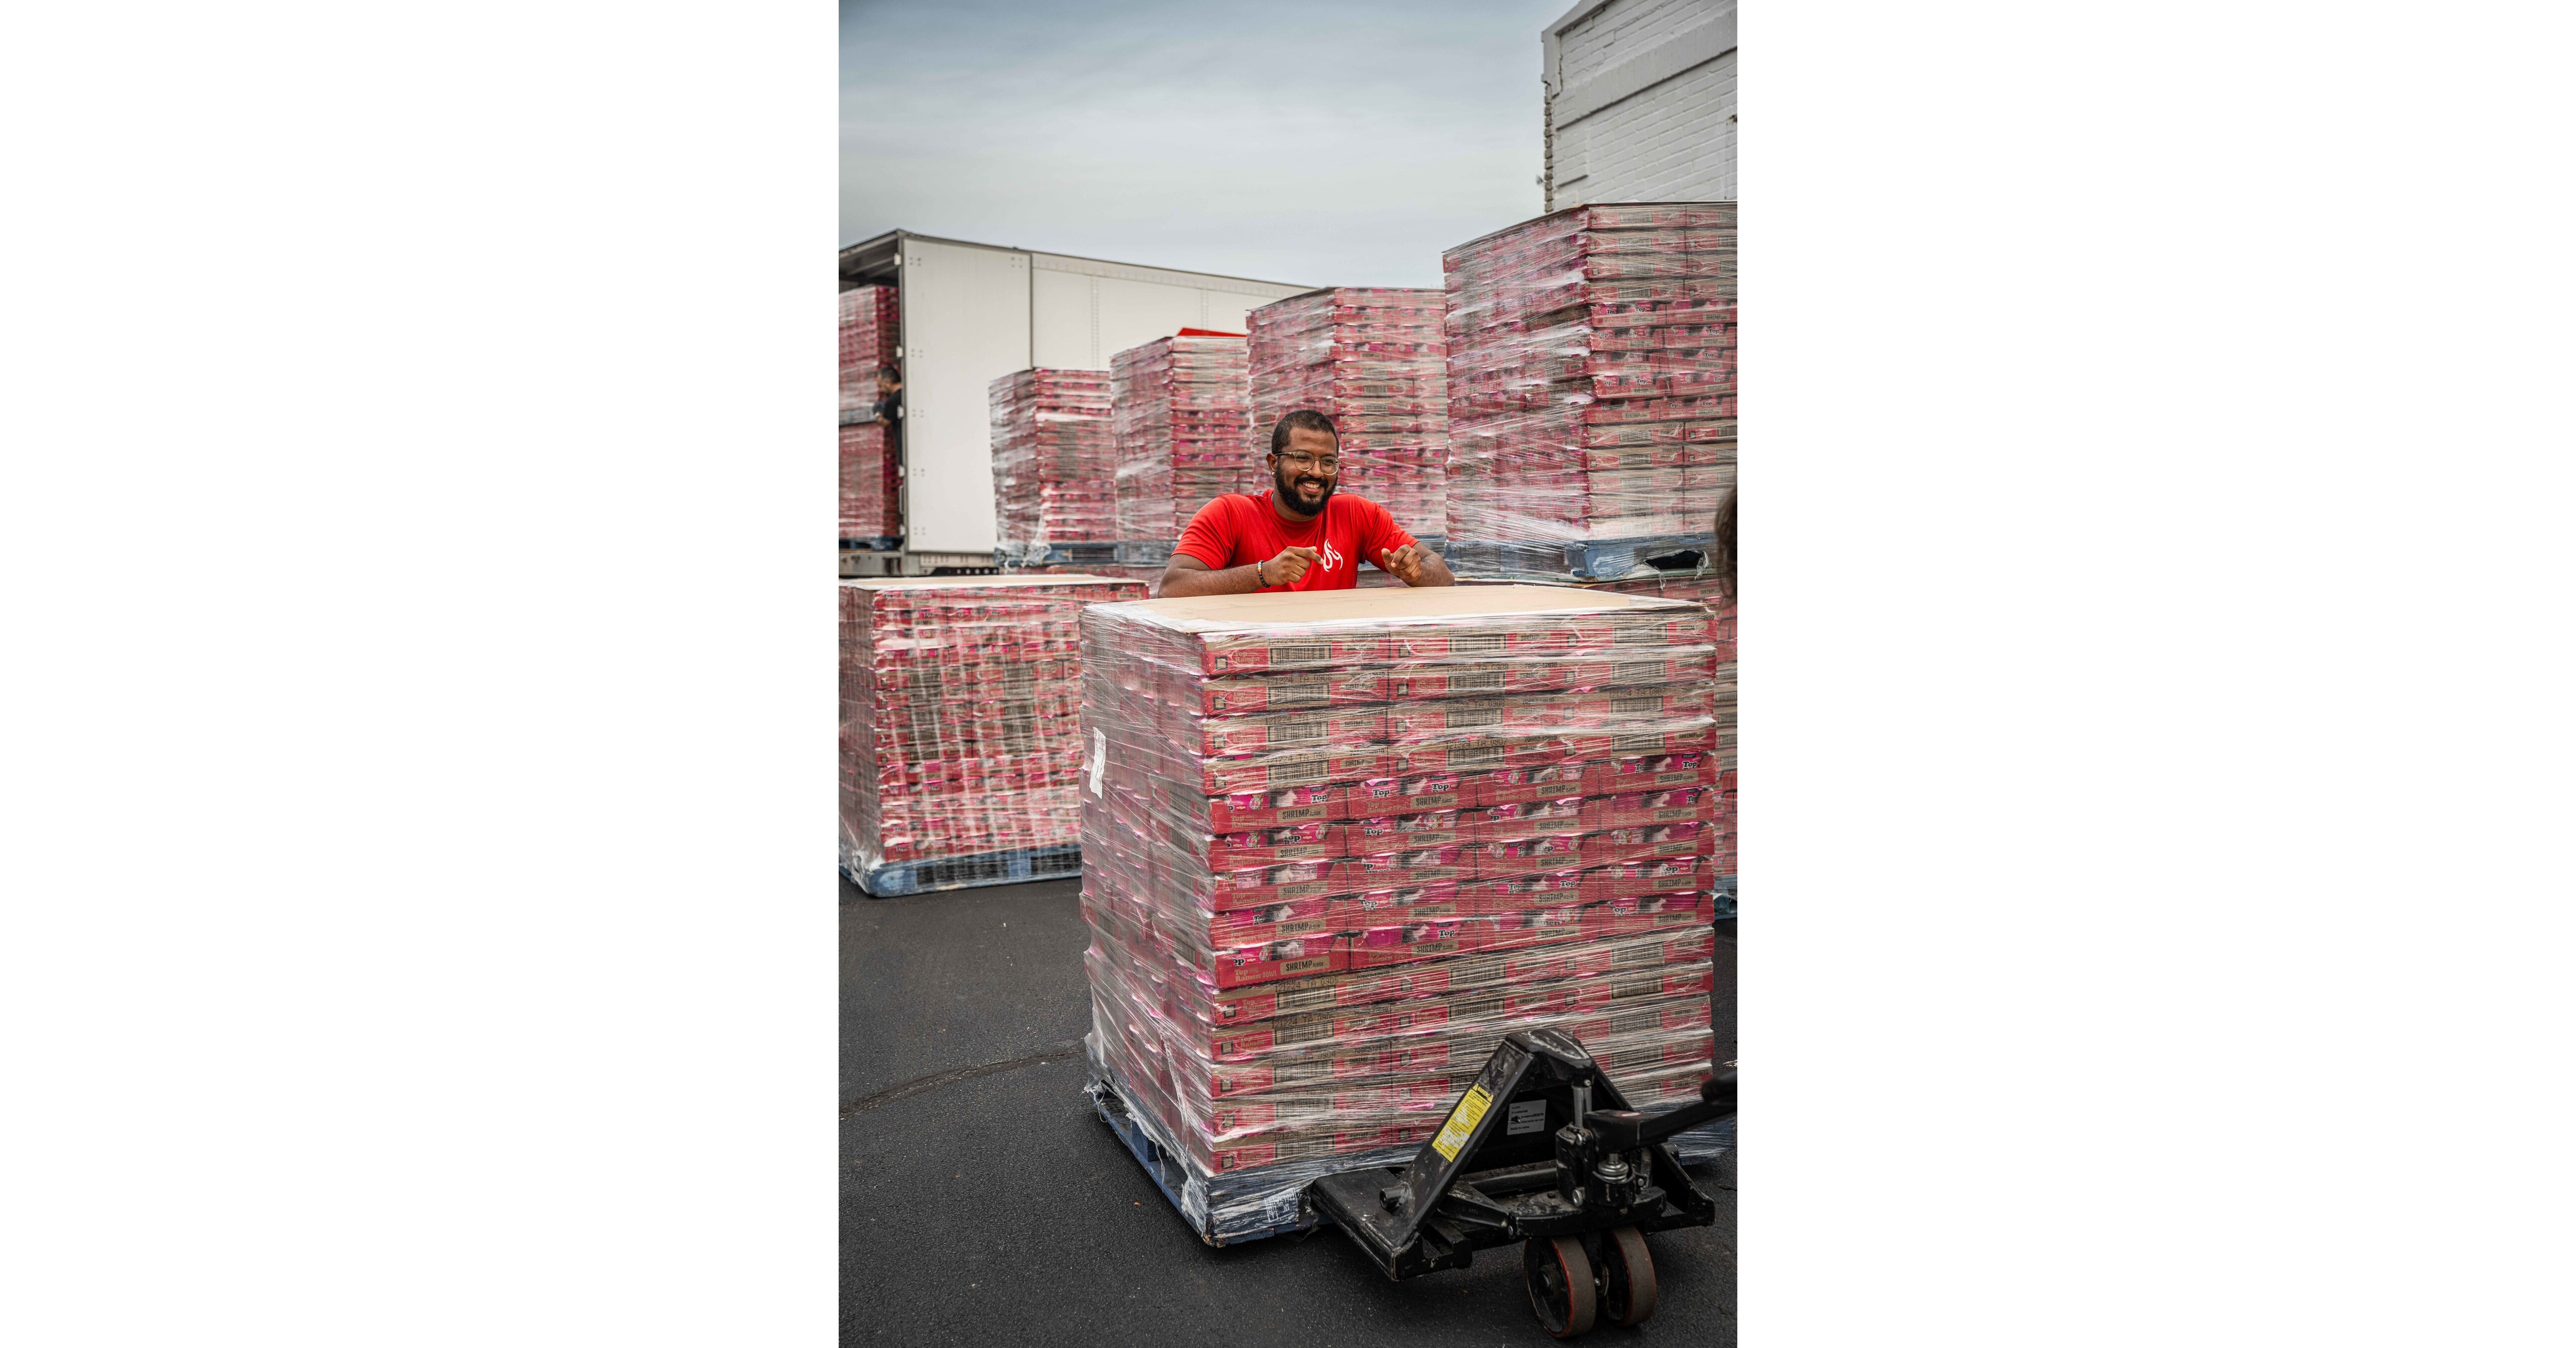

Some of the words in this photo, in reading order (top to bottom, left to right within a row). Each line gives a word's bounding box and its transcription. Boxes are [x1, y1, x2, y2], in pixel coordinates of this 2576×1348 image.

[1265, 716, 1292, 724] 121224
[1344, 719, 1364, 727] SHRIMP
[1659, 774, 1683, 783] SHRIMP
[1542, 785, 1565, 794] SHRIMP
[1416, 797, 1441, 806] SHRIMP
[1282, 809, 1309, 819] SHRIMP
[1658, 810, 1681, 819] SHRIMP
[1540, 821, 1563, 830] SHRIMP
[1414, 834, 1439, 843] SHRIMP
[1280, 848, 1307, 858] SHRIMP
[1659, 844, 1682, 853] SHRIMP
[1541, 857, 1565, 866] SHRIMP
[1416, 870, 1441, 879] SHRIMP
[1658, 879, 1681, 888] SHRIMP
[1283, 886, 1310, 895] SHRIMP
[1539, 893, 1563, 902] SHRIMP
[1414, 907, 1439, 916] SHRIMP
[1658, 913, 1681, 923] SHRIMP
[1282, 923, 1308, 933] SHRIMP
[1417, 943, 1442, 953] SHRIMP
[1286, 960, 1312, 971] SHRIMP
[1275, 981, 1301, 992] 121224
[1271, 1018, 1298, 1028] 121224
[1478, 1086, 1491, 1098] WARNING
